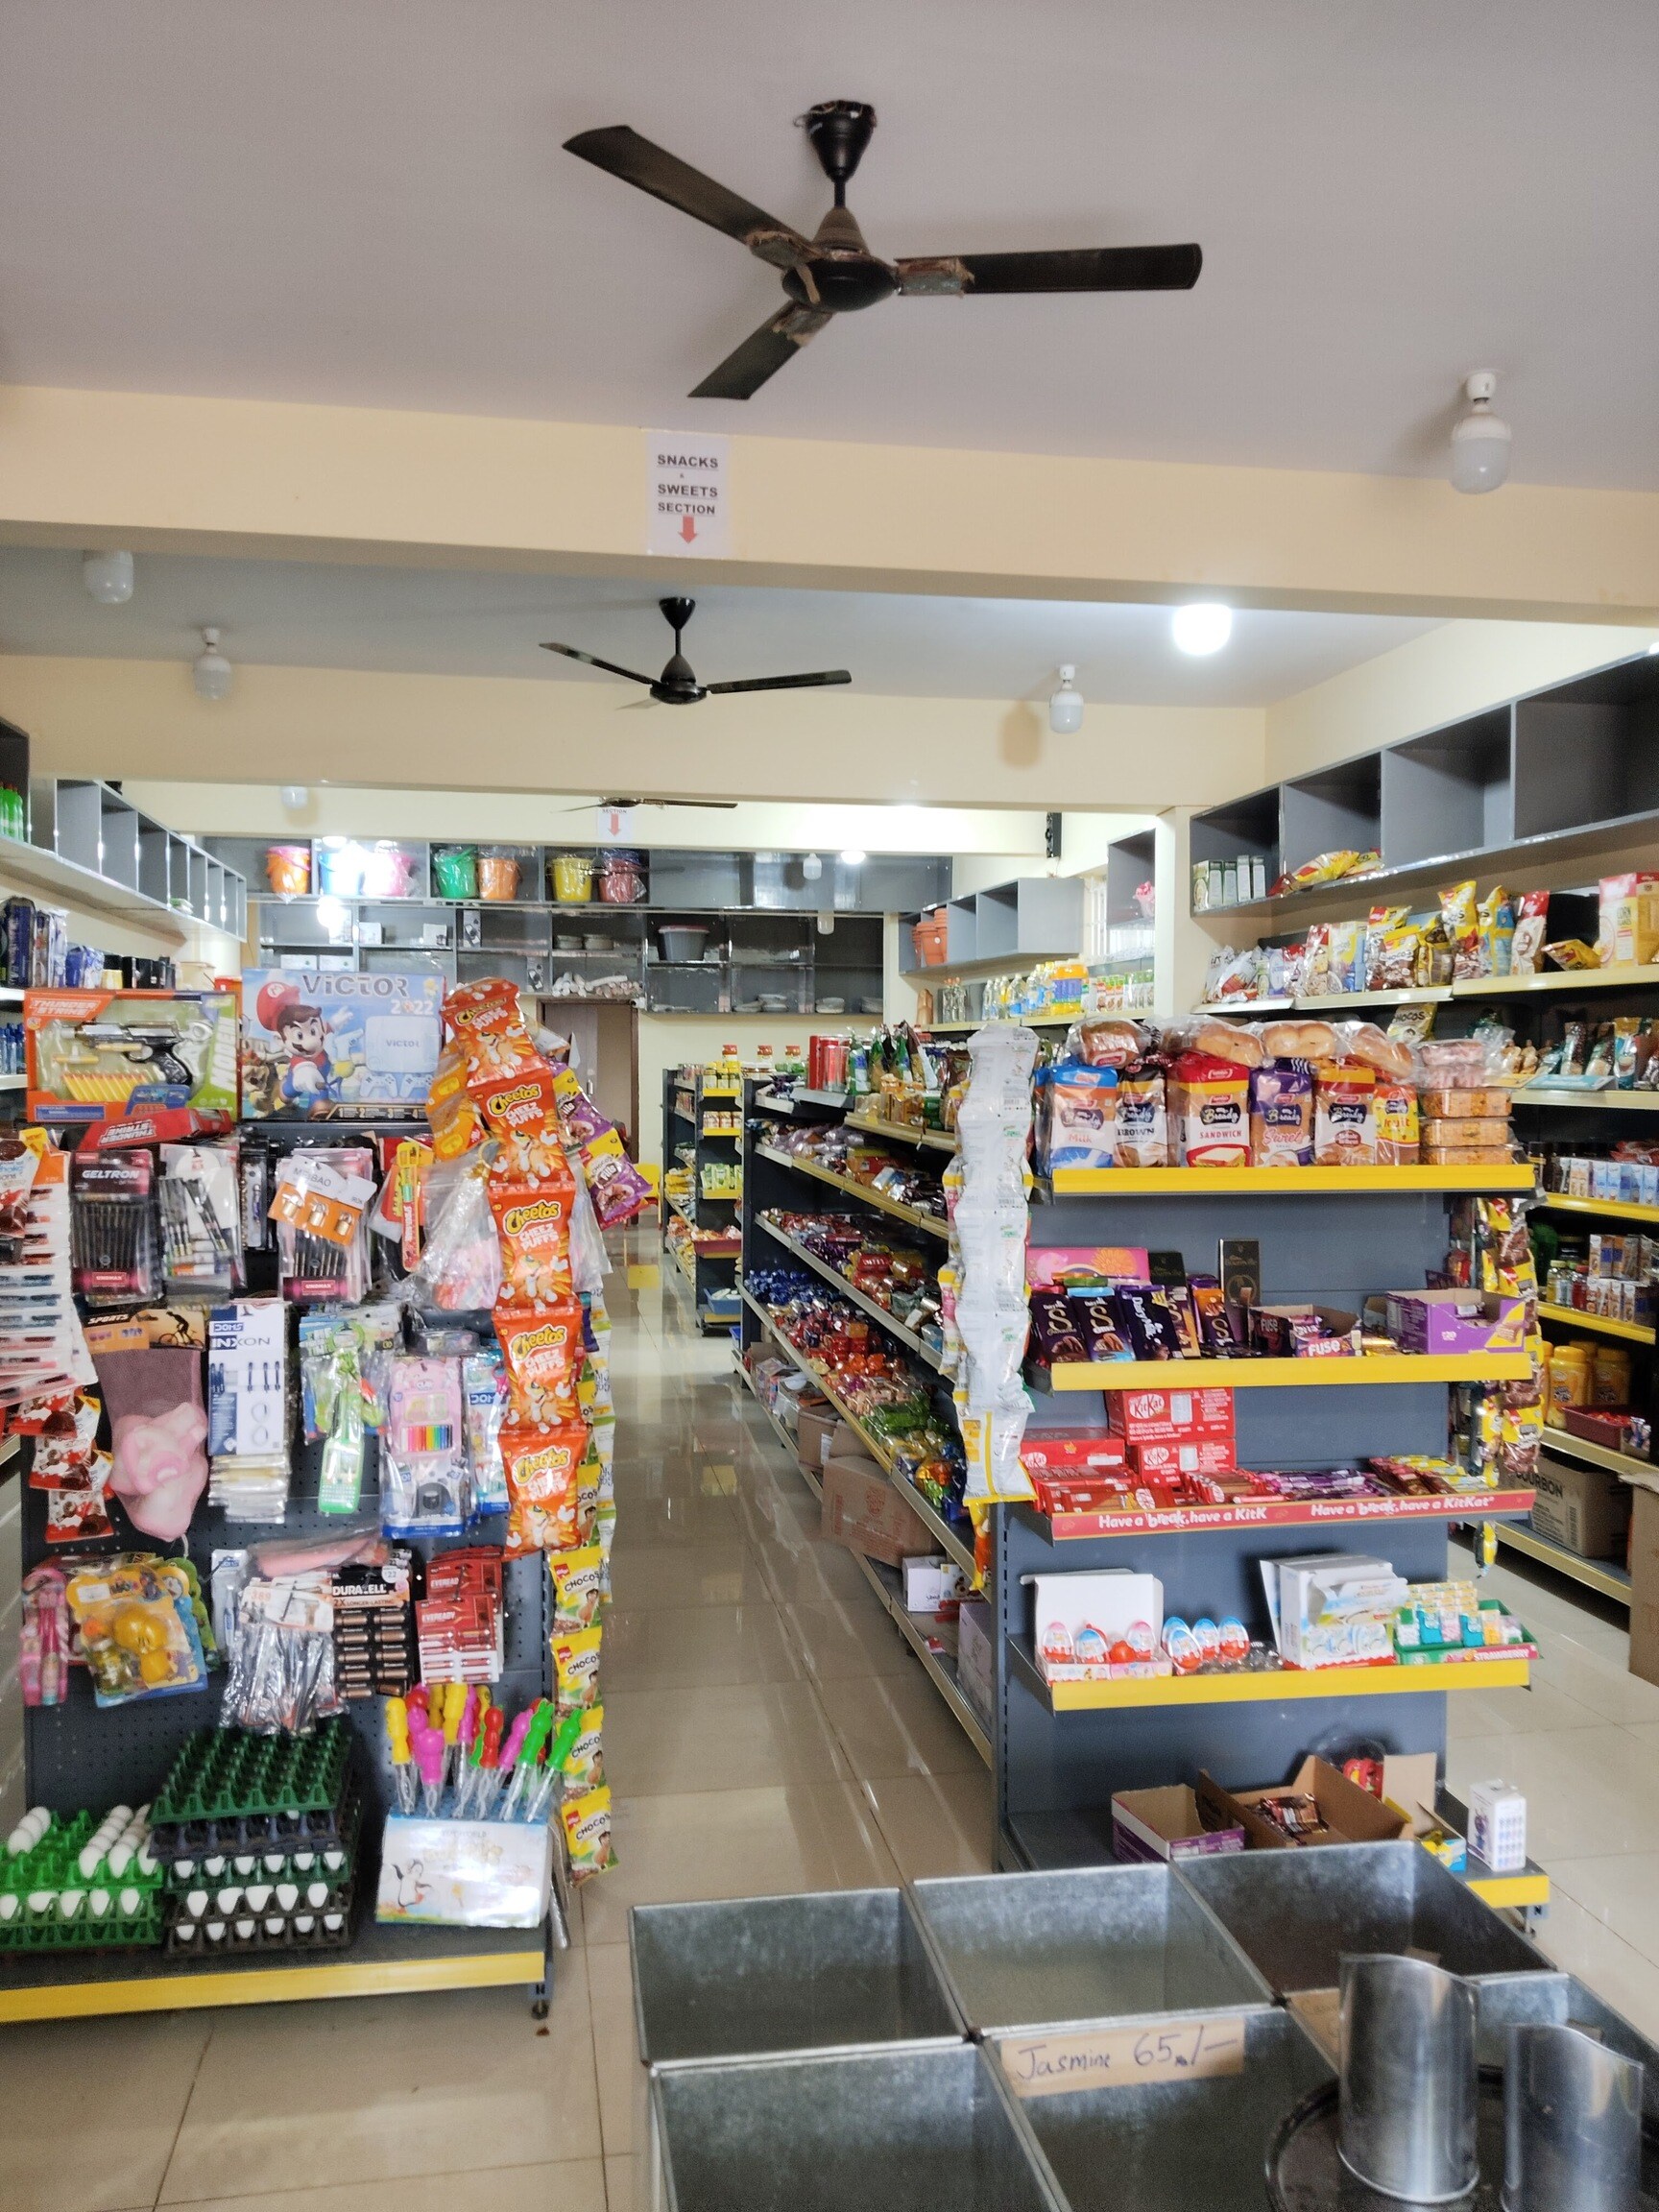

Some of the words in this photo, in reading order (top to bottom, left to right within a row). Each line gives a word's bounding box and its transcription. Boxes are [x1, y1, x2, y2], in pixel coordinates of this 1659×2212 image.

[657, 454, 718, 469] SNACKS
[658, 484, 718, 497] SWEETS
[658, 502, 715, 515] SECTION
[491, 1086, 539, 1112] Cheetos
[1200, 1130, 1241, 1139] SANDWICH
[82, 1169, 140, 1179] GELTRON
[505, 1201, 559, 1231] Cheetos
[87, 1313, 129, 1325] SPORTS
[513, 1327, 565, 1357] Cheetos
[1309, 1340, 1340, 1356] FUSE
[1134, 1395, 1163, 1417] KitKat
[1311, 1504, 1343, 1517] Have
[1346, 1505, 1356, 1515] a
[1401, 1500, 1430, 1512] have
[1431, 1501, 1441, 1510] a
[1444, 1497, 1494, 1508] KitKat
[1098, 1514, 1133, 1529] Have
[1135, 1517, 1143, 1527] a
[1190, 1509, 1219, 1524] have
[1222, 1512, 1232, 1522] a
[431, 1577, 459, 1589] EVEREAD
[565, 1572, 601, 1592] CHOCOS
[567, 1653, 601, 1675] CHOCOS
[1474, 1648, 1530, 1661] STRAWBERRY
[576, 1813, 611, 1840] CHOCOS
[1017, 2044, 1111, 2080] Jasmine
